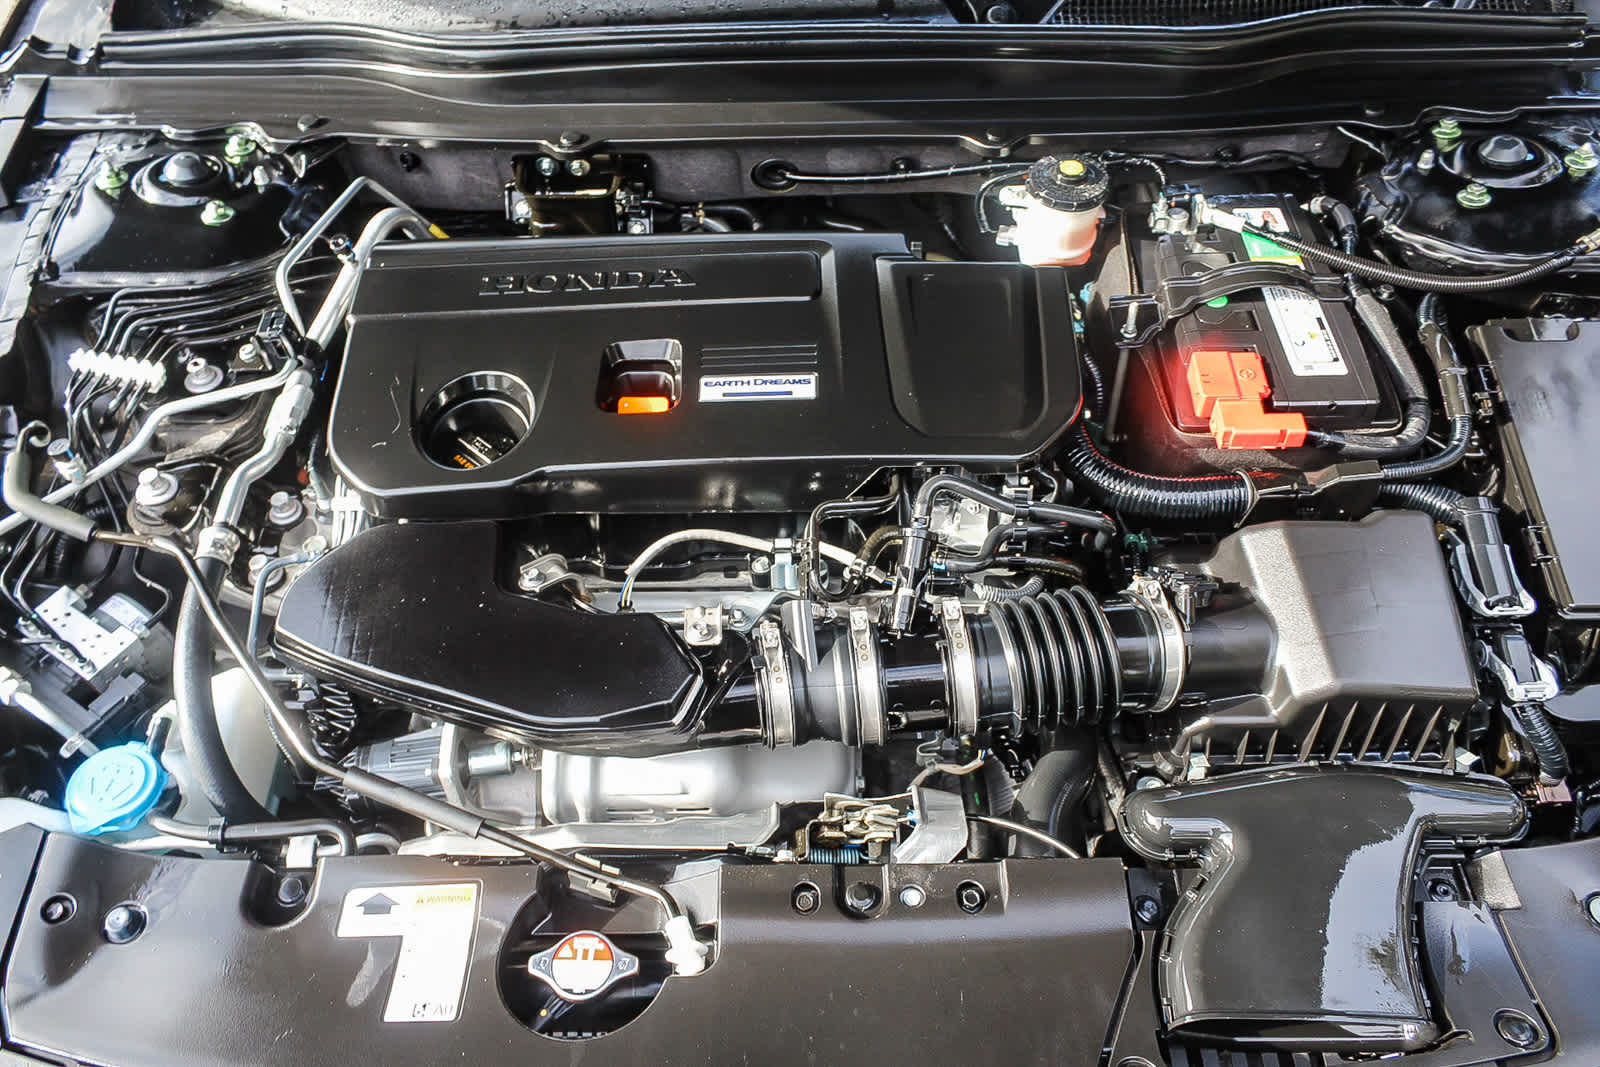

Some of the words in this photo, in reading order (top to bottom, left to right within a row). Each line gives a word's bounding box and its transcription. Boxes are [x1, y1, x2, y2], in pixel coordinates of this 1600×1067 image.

[479, 269, 697, 296] HONDA
[703, 380, 751, 388] EARTH
[753, 378, 812, 386] DREAMS
